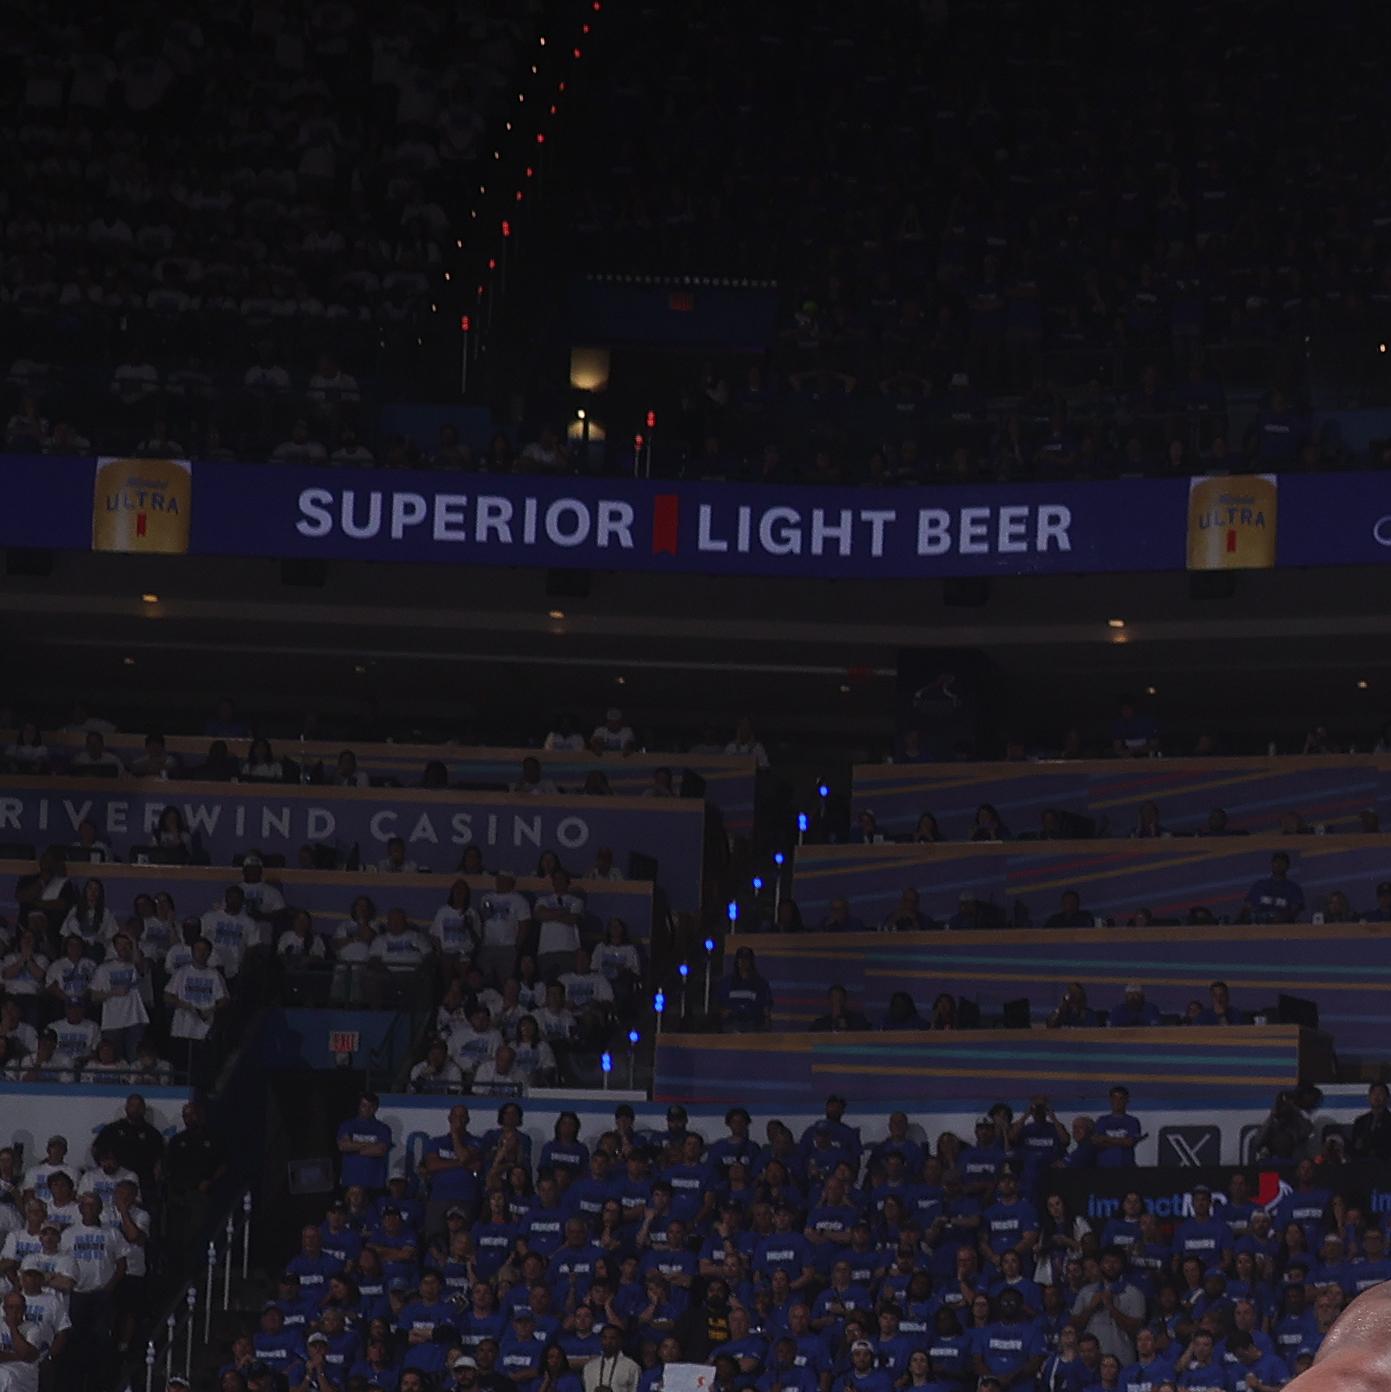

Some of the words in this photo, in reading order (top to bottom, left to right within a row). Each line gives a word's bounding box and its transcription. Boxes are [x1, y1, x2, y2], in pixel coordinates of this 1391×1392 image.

[294, 486, 635, 550] SUPERIOR
[697, 503, 896, 558] LIGHT
[916, 504, 1073, 556] BEER
[370, 808, 592, 851] CASINO
